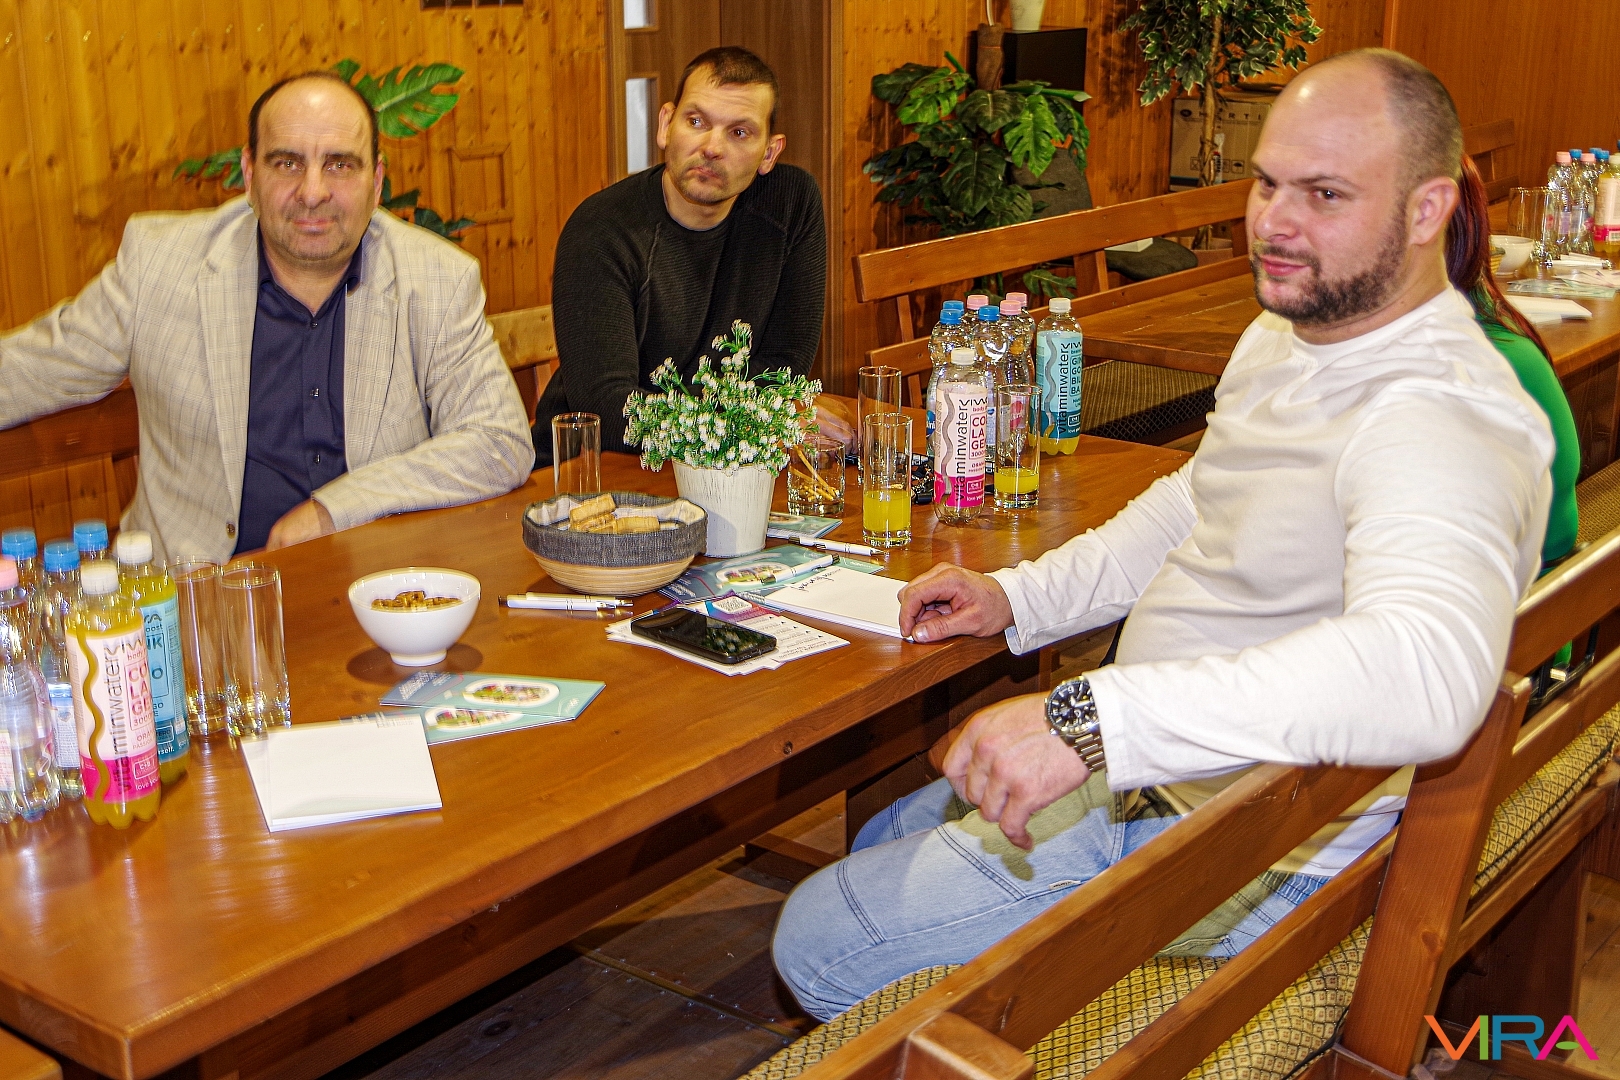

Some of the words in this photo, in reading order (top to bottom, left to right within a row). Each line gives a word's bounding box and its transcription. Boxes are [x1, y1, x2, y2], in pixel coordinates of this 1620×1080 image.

[1057, 348, 1069, 434] vitaminwater
[954, 405, 968, 501] vitaminwater
[104, 653, 132, 796] vitaminwater
